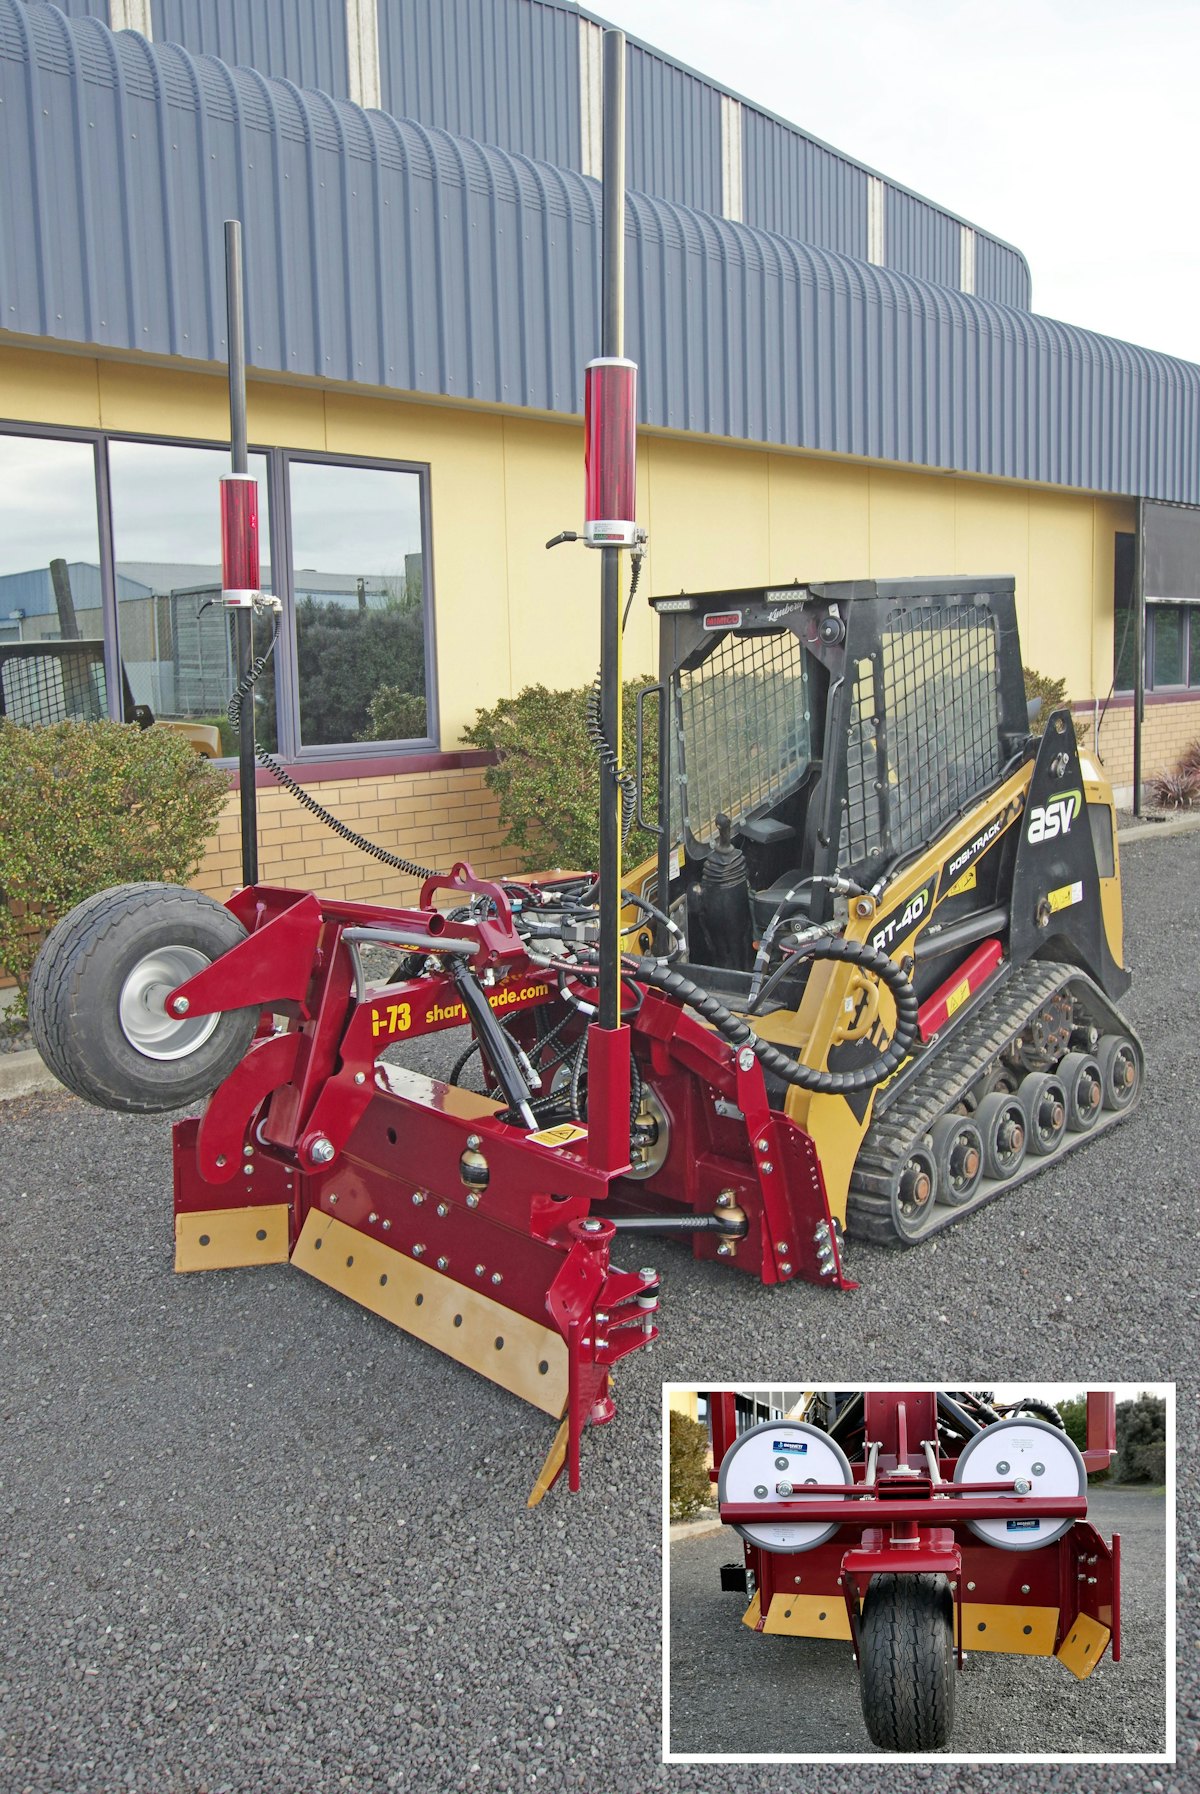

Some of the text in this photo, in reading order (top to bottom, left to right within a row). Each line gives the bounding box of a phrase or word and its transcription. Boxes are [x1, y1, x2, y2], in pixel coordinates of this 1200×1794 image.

[949, 820, 1001, 876] POSI-TRACK
[873, 897, 924, 953] RT-40
[425, 984, 548, 1024] sharpade.com
